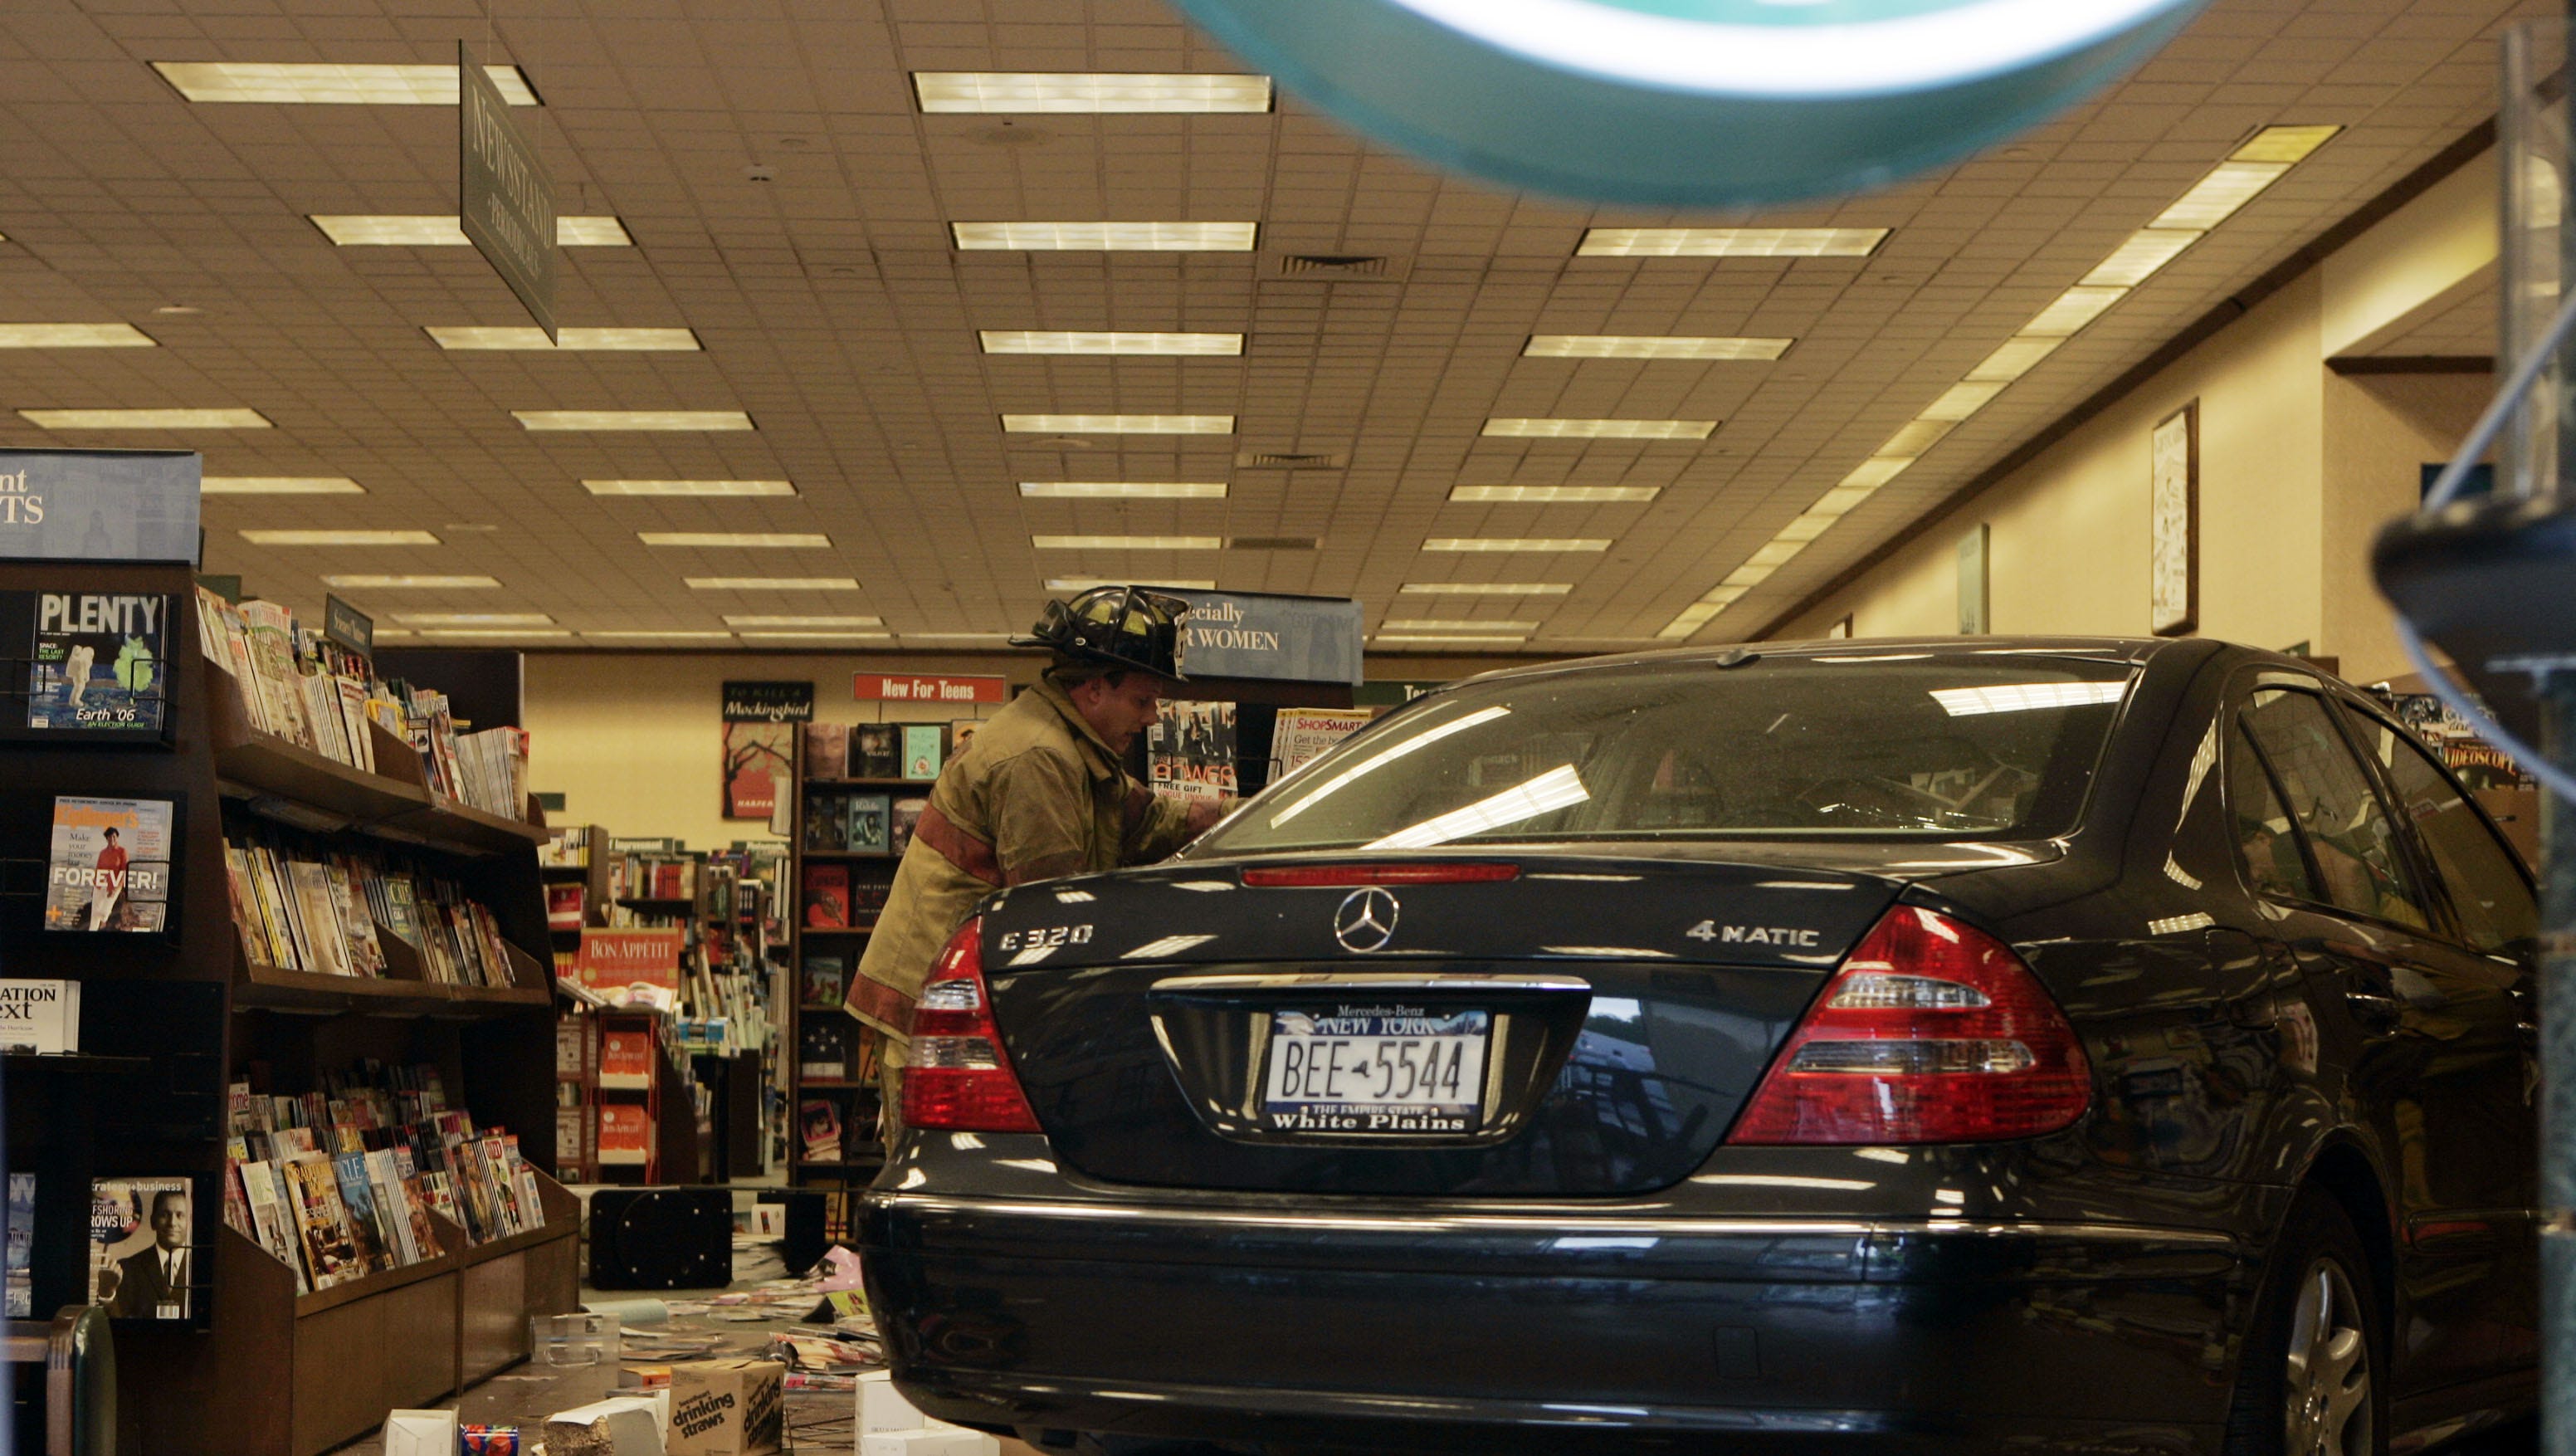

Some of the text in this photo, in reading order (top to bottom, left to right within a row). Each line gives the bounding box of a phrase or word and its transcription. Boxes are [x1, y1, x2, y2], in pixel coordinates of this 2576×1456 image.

[472, 85, 553, 250] NEWSSTAND
[41, 594, 159, 634] PLENTY
[1197, 628, 1279, 651] WOMEN
[882, 678, 974, 700] New For Teens
[76, 708, 110, 721] Earth
[725, 701, 810, 722] Mockingbird
[1294, 735, 1311, 745] Get
[1313, 735, 1327, 745] the
[1159, 782, 1203, 794] FREE GIFT
[70, 833, 90, 842] Make
[54, 867, 158, 890] FOREVER!
[999, 924, 1094, 950] E 320
[591, 939, 617, 959] BON
[0, 1001, 33, 1019] xt
[1338, 1004, 1425, 1018] Mercedes-Benz
[1322, 1017, 1436, 1036] NEW YORK
[1282, 1041, 1463, 1099] BEE 5544
[1313, 1104, 1426, 1115] THE EMPIRE STATE
[1272, 1114, 1465, 1130] White Plains
[120, 1216, 133, 1228] UP
[673, 1392, 735, 1427] drinking
[744, 1375, 781, 1434] drinking
[681, 1412, 725, 1439] straws
